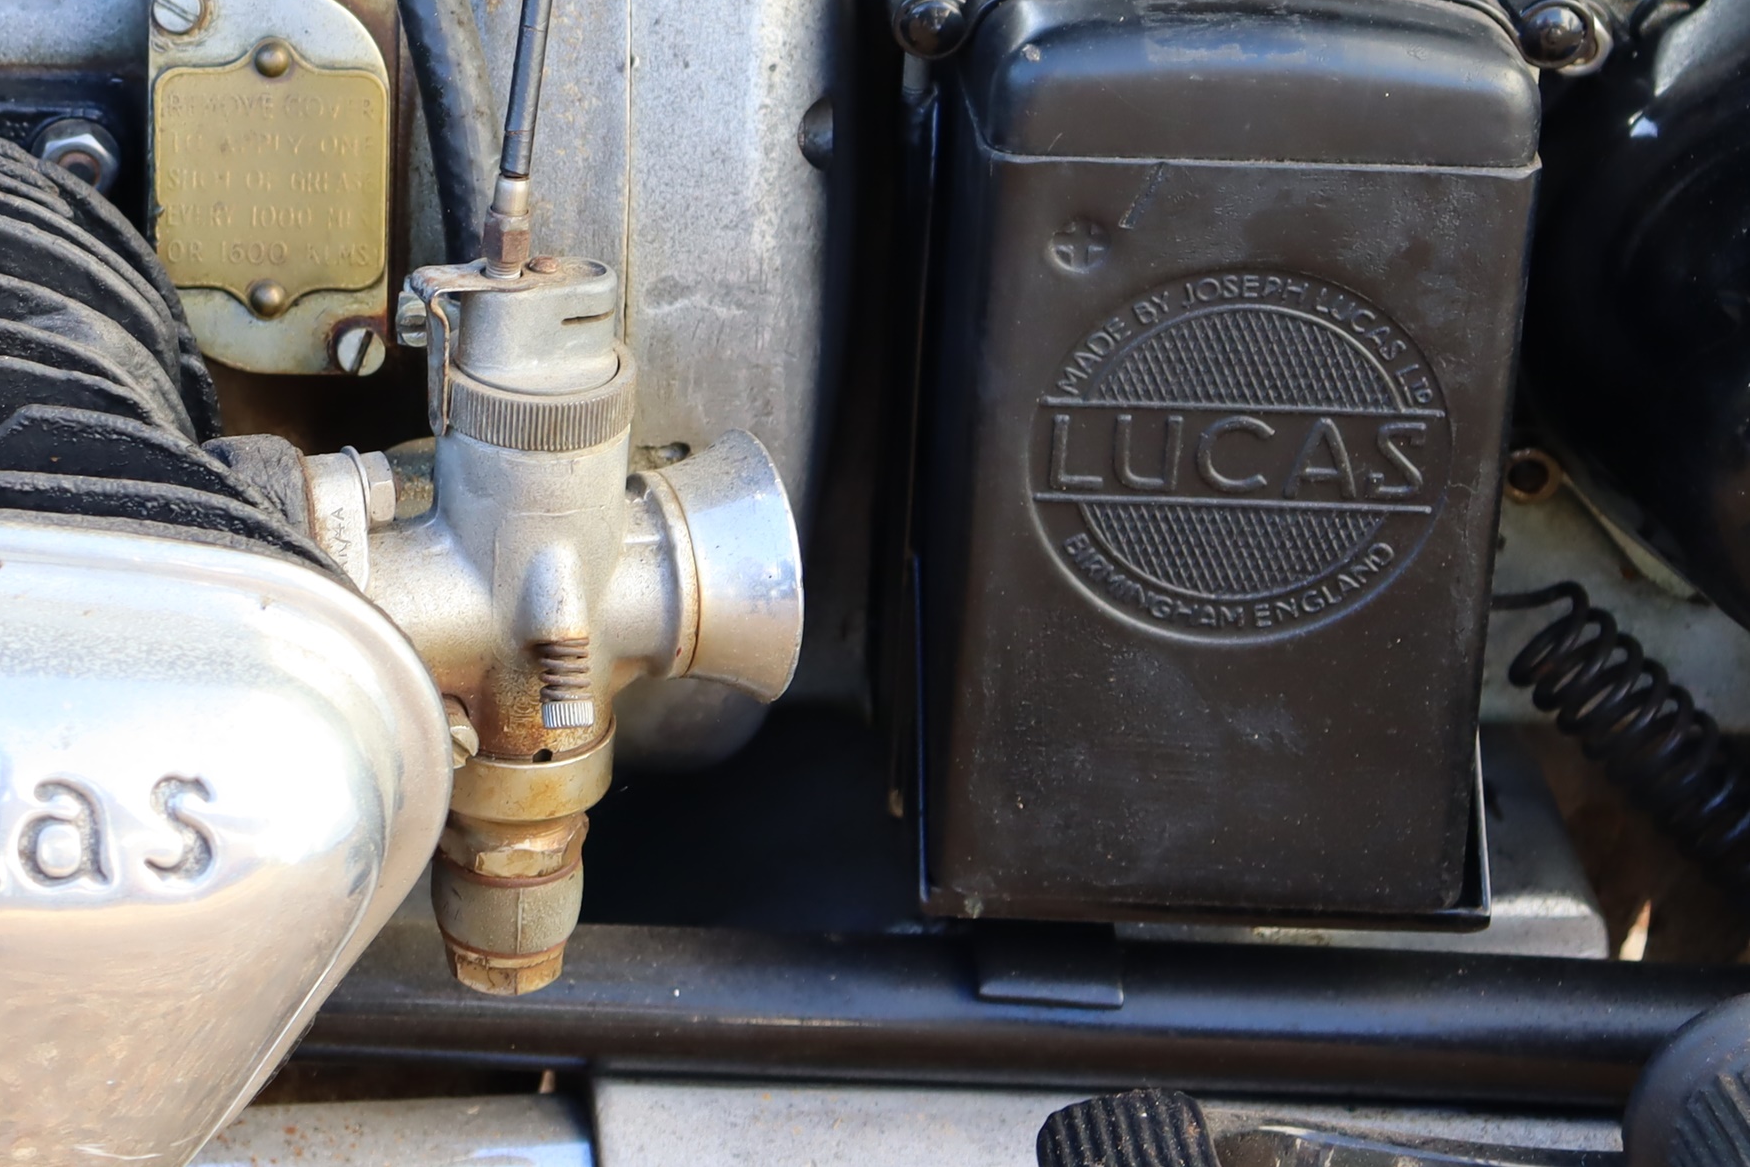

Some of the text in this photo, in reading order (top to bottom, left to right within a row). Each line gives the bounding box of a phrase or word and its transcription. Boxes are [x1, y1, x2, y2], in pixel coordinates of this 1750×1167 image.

[168, 129, 204, 153] TO
[319, 133, 375, 157] ONE
[166, 166, 233, 192] SHOT
[289, 170, 375, 195] GREASE
[165, 202, 236, 228] EVERY
[250, 205, 313, 230] 1000
[166, 238, 204, 265] OR
[220, 239, 288, 268] 1600
[1055, 315, 1134, 398] MADE
[1131, 289, 1172, 326] BY
[1180, 273, 1310, 309] JOSEPH
[1314, 285, 1408, 363] LUCAS
[1048, 413, 1428, 501] LUCAS
[1062, 531, 1396, 629] BIRMINGHAM ENGLAND
